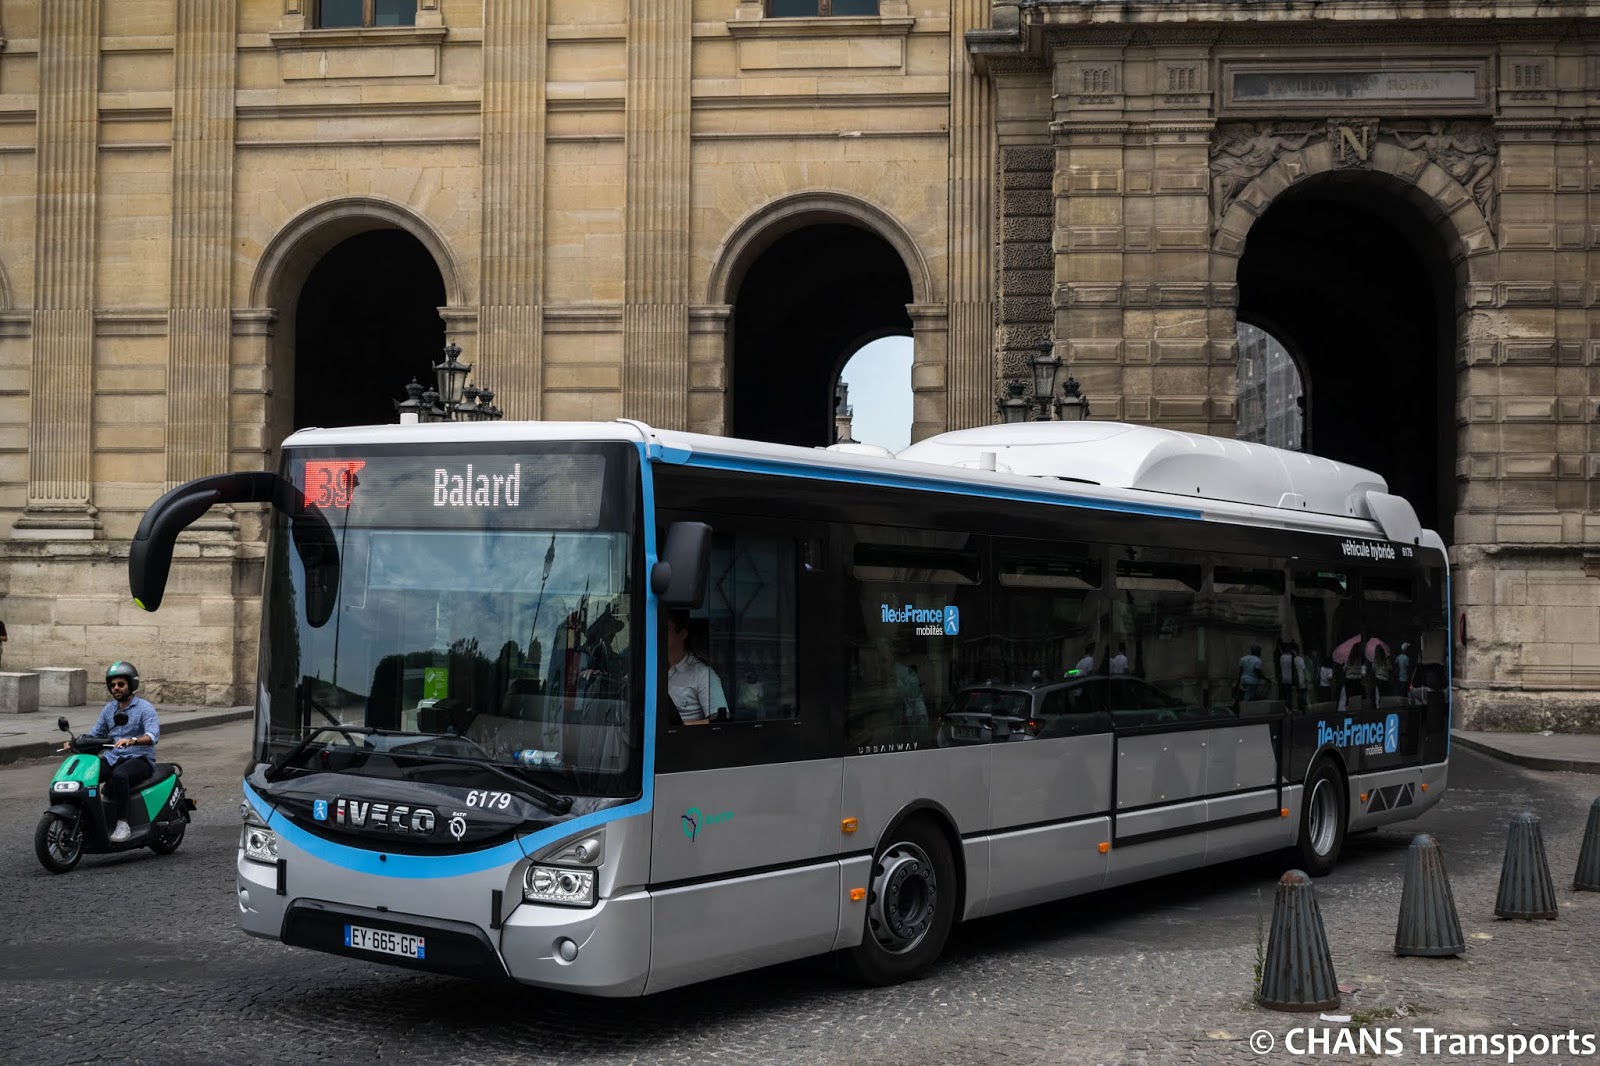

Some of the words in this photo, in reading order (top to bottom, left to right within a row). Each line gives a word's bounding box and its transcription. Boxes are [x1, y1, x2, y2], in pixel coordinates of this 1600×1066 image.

[1339, 126, 1369, 162] N
[316, 467, 351, 506] 39
[433, 463, 521, 506] Balard
[1341, 539, 1370, 557] véhicule
[1369, 542, 1396, 561] hybride
[1401, 547, 1413, 557] 6179
[915, 624, 943, 636] mobilités
[858, 742, 918, 754] URBANWAY
[465, 790, 512, 810] 6179
[336, 798, 436, 837] IVECO
